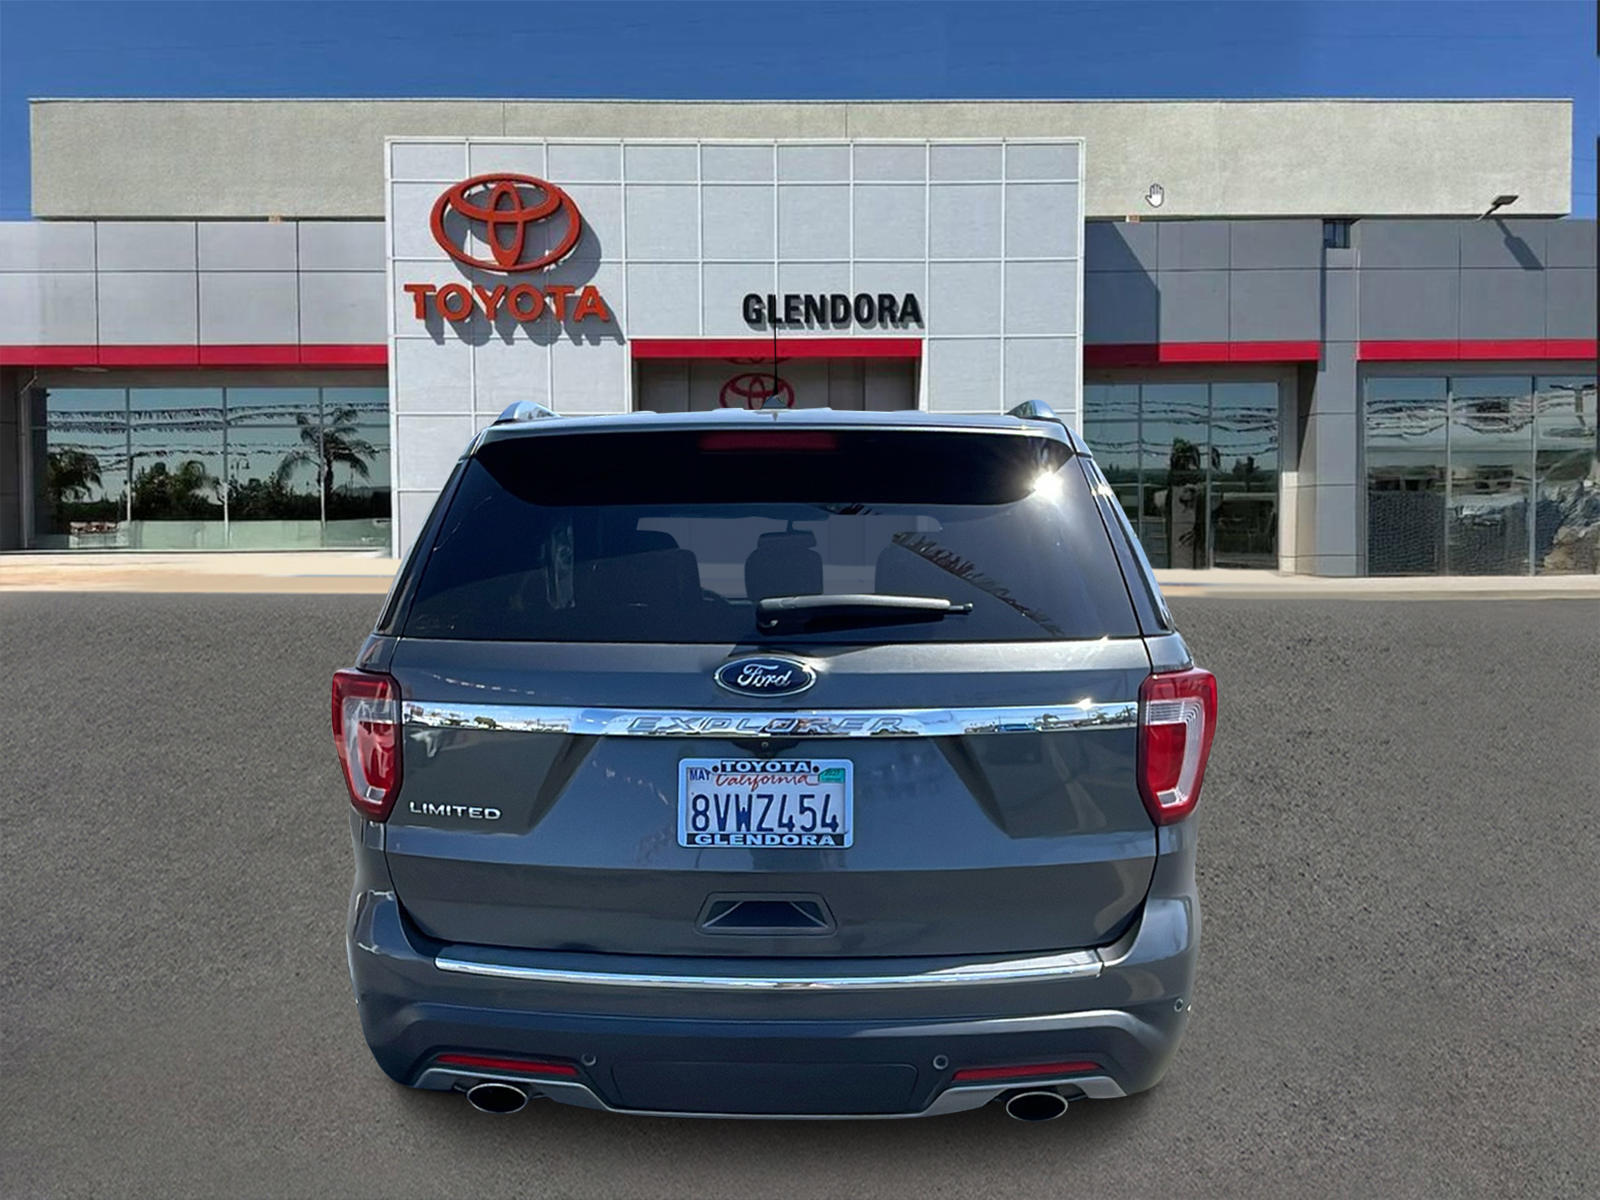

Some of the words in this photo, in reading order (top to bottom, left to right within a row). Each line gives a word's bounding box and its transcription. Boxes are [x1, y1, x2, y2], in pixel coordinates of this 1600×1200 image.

[404, 284, 609, 322] TOYOTA
[743, 293, 922, 325] GLENDORA
[737, 663, 792, 687] Ford
[627, 716, 903, 733] EXPLORER
[690, 769, 710, 781] MAY
[722, 761, 810, 772] TOYOTA
[715, 774, 820, 791] California
[410, 802, 501, 819] LIMITED
[692, 794, 839, 832] 8VWZ454
[695, 834, 835, 845] GLENDORA
